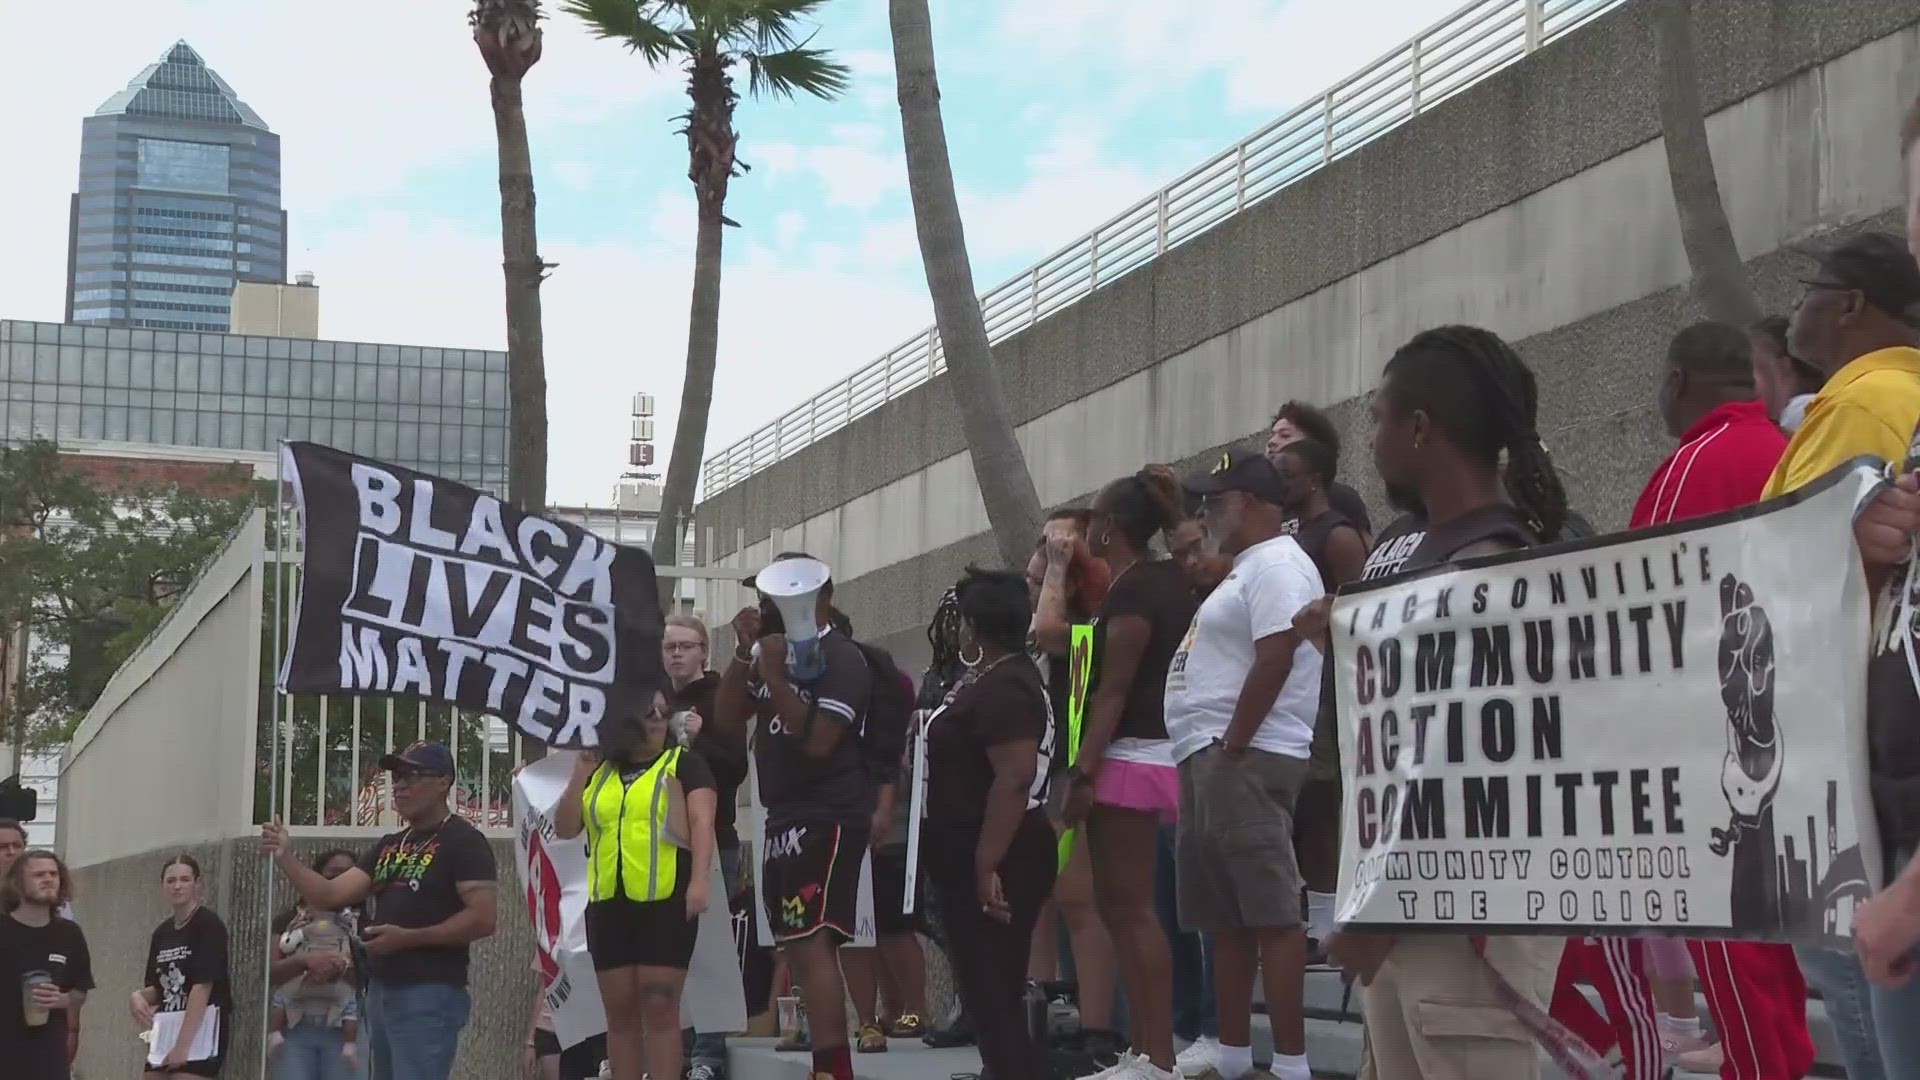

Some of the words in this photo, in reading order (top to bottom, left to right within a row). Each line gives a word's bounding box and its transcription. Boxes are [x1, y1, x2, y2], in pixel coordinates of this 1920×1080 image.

[351, 462, 616, 606] BLACK
[346, 534, 612, 676] LIVES
[339, 622, 606, 747] MATTER
[1356, 600, 1686, 705] COMMUNITY
[1356, 695, 1562, 778] ACTION
[1357, 766, 1685, 849] COMMITTEE
[1398, 890, 1488, 921] THE
[1527, 888, 1689, 922] POLICE
[1550, 846, 1692, 880] CONTROL
